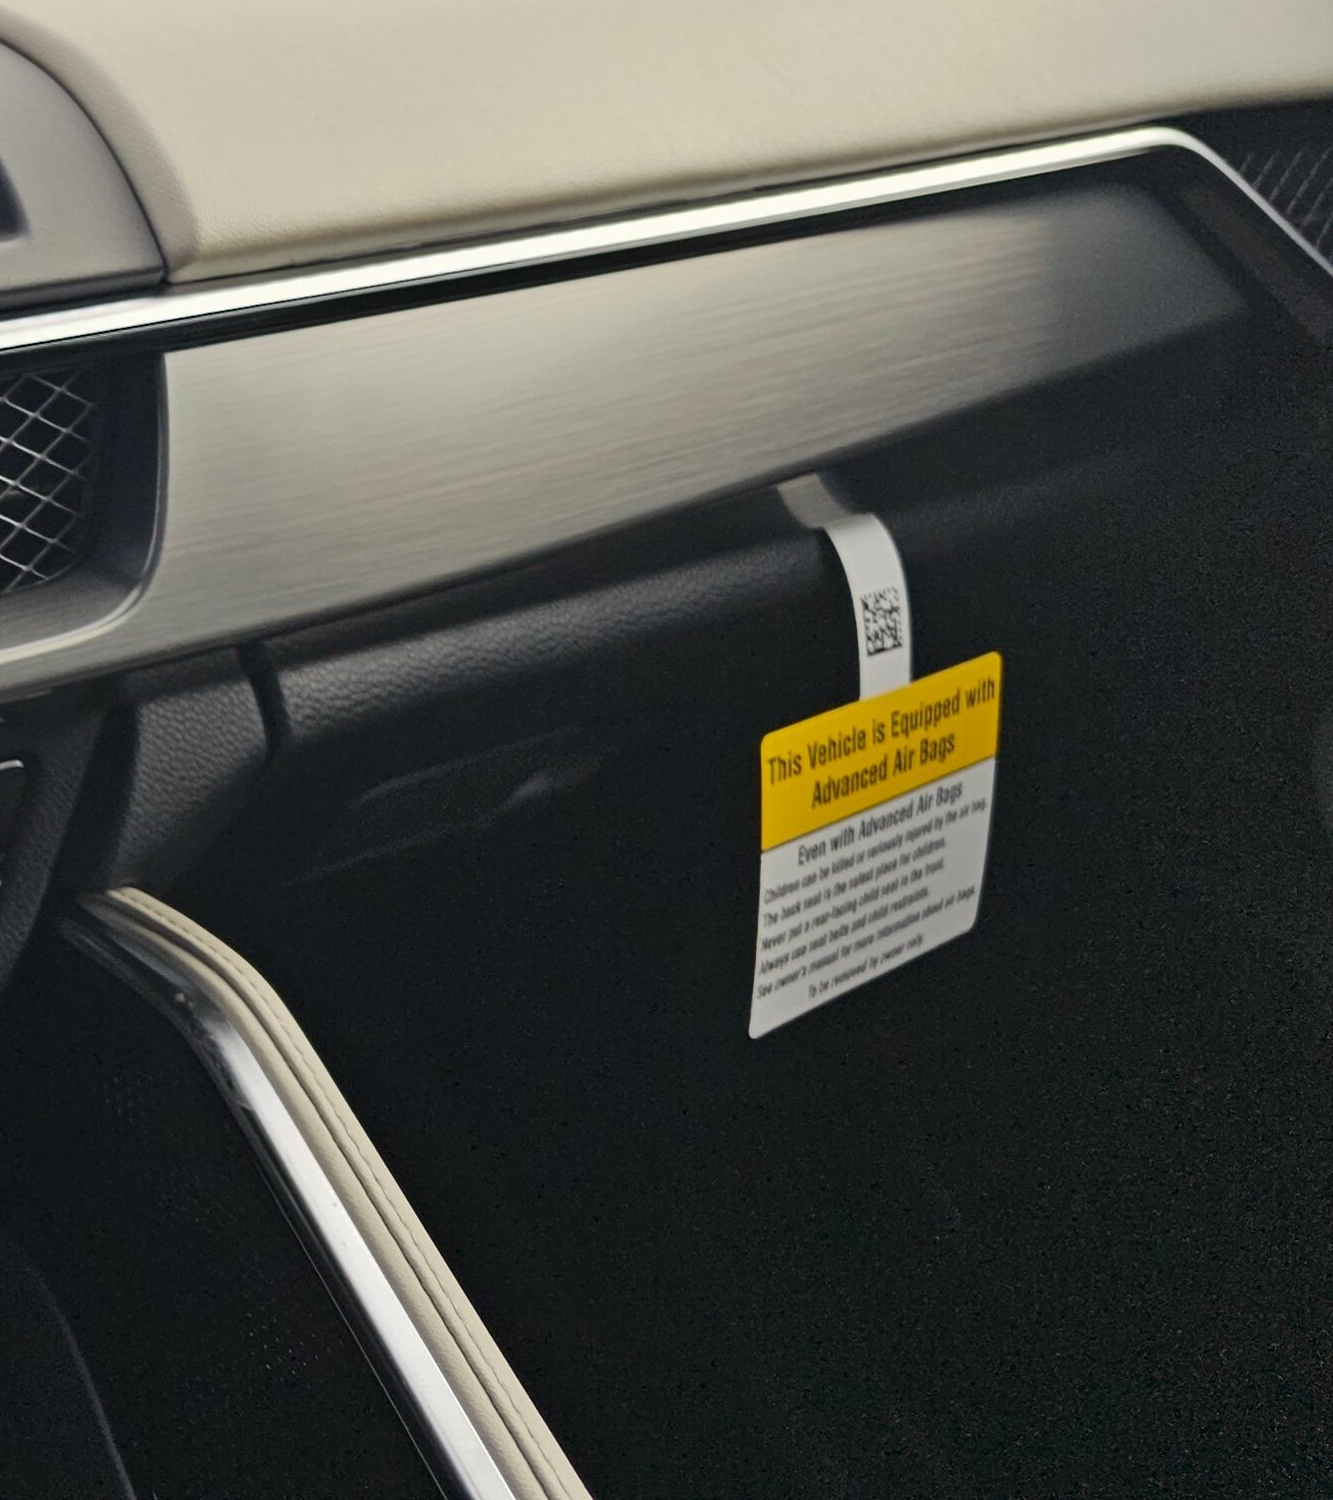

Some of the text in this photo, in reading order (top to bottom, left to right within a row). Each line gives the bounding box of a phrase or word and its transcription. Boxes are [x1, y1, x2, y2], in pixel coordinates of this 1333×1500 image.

[767, 677, 995, 786] This Vehicle is Equipped with
[811, 731, 956, 810] Advanced Air Bags
[798, 782, 962, 866] Even with Advanced Air Bags
